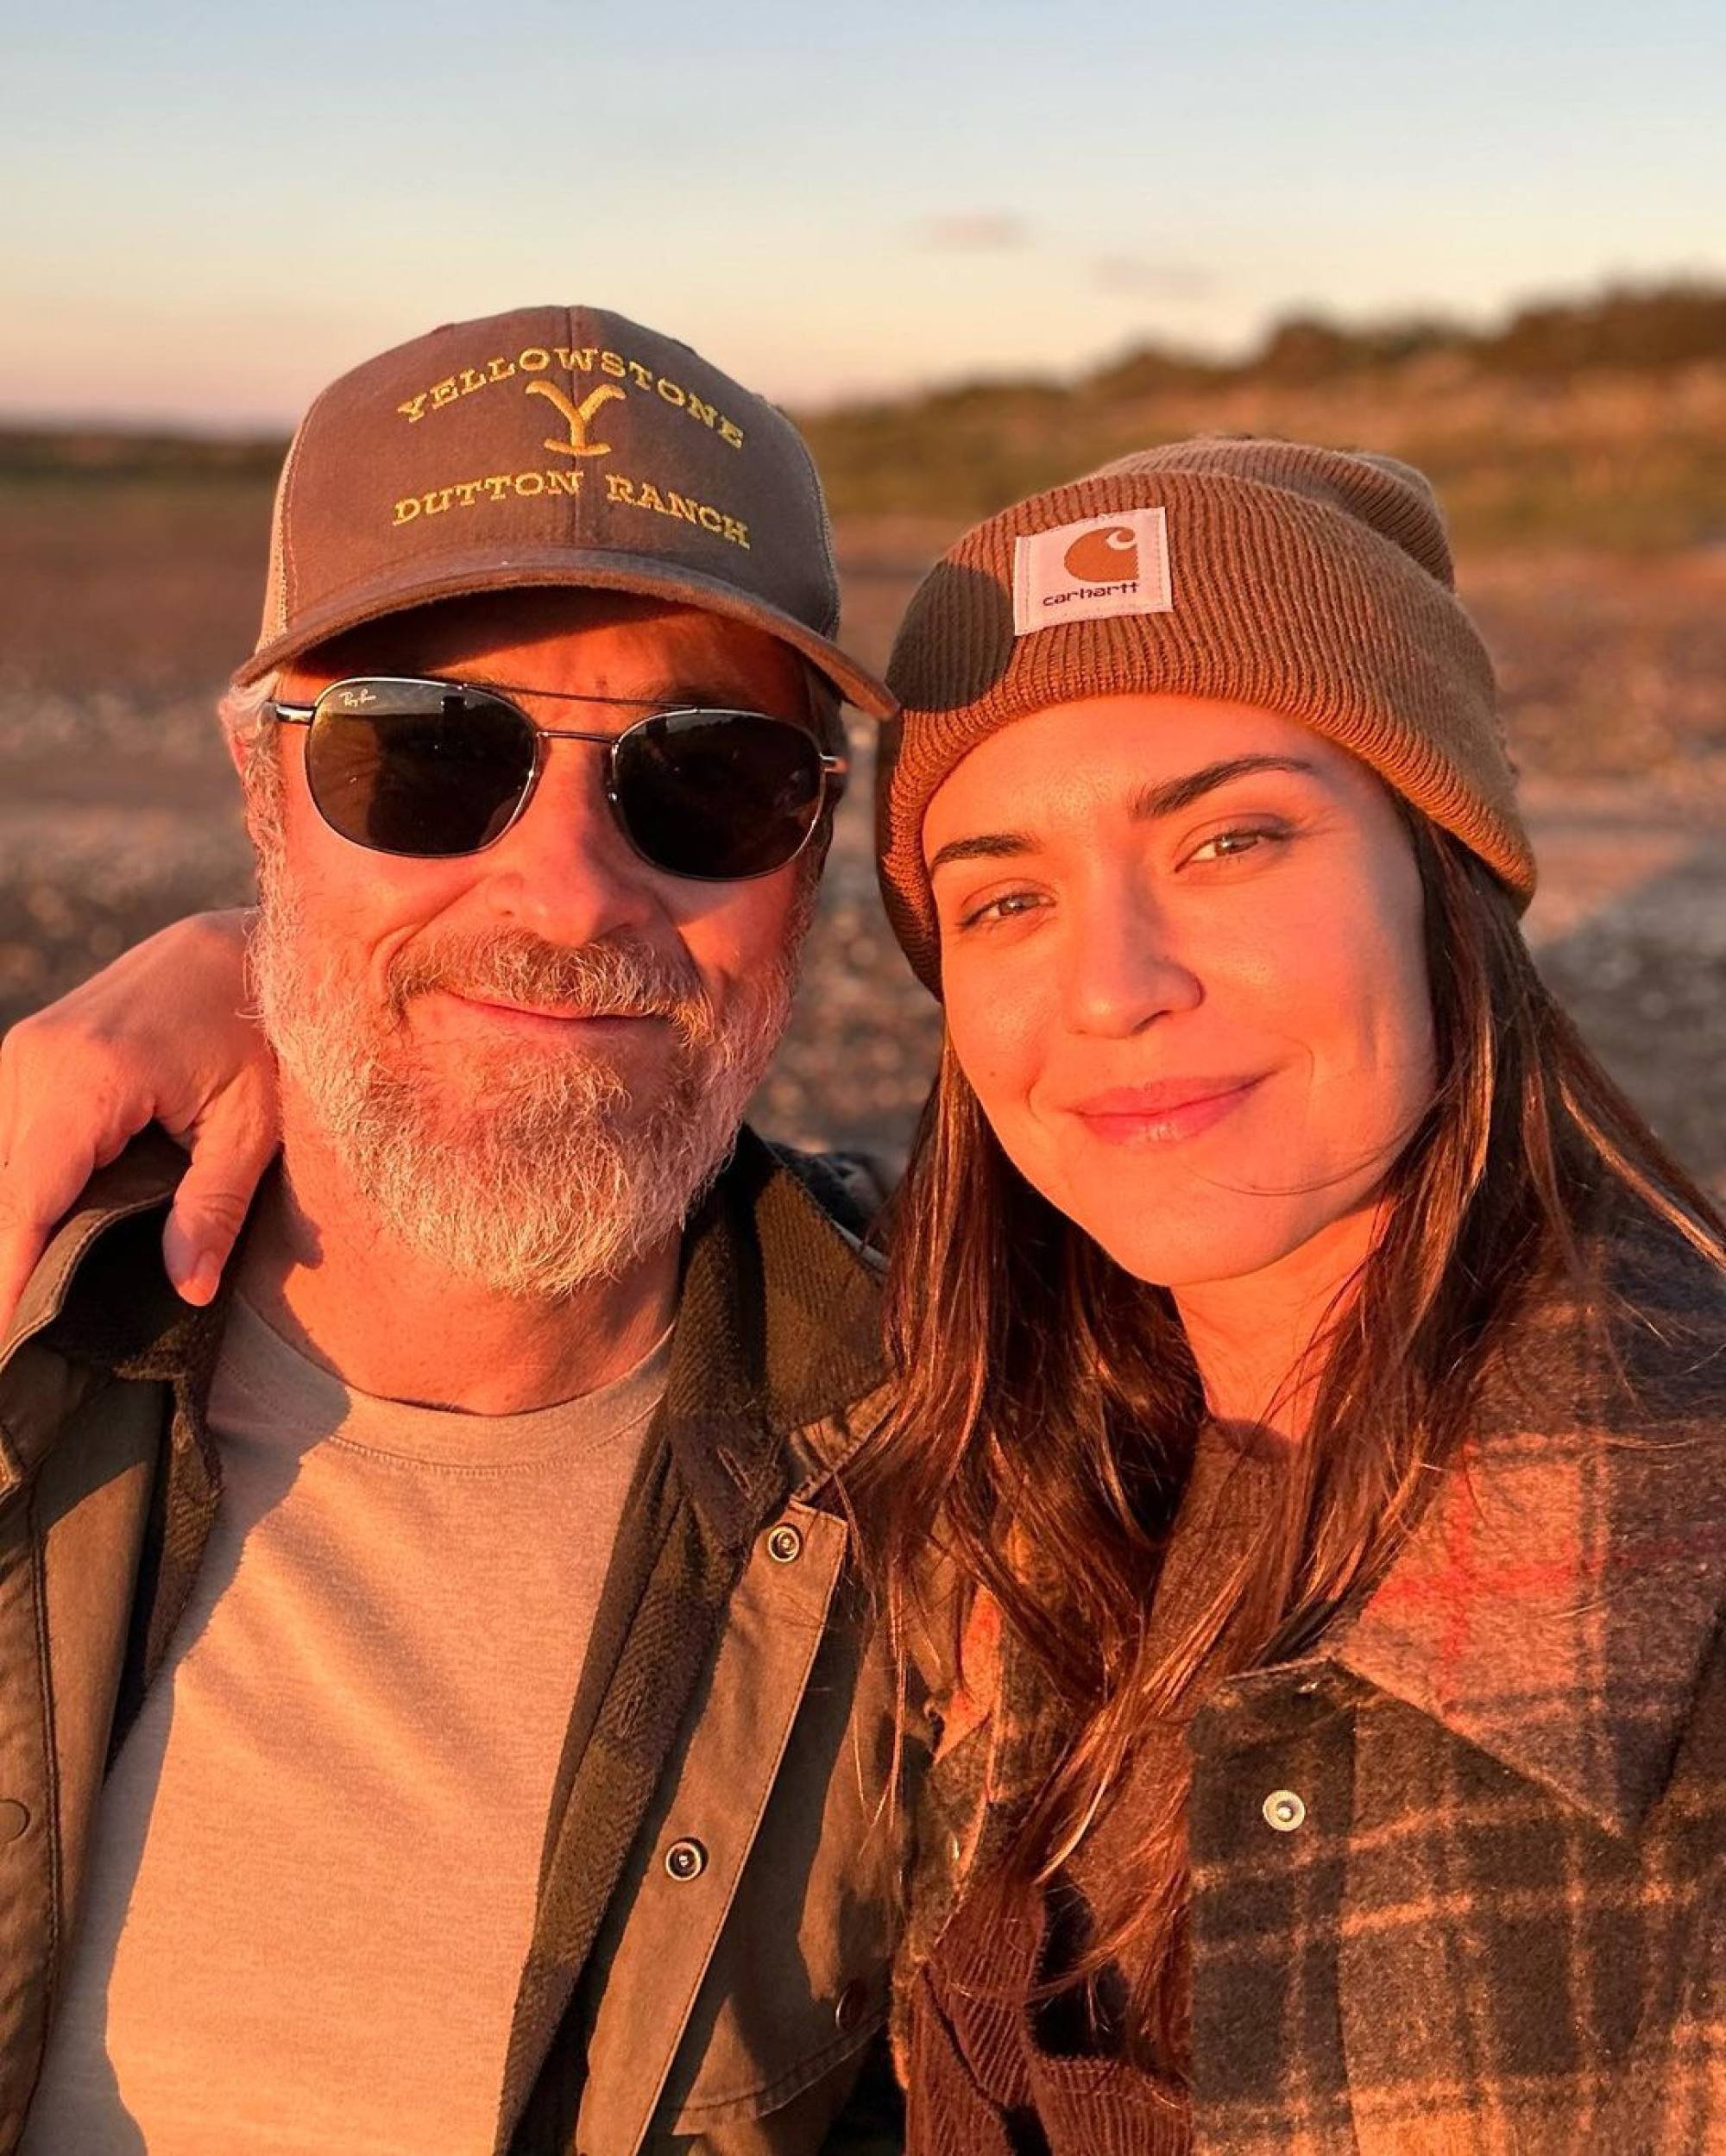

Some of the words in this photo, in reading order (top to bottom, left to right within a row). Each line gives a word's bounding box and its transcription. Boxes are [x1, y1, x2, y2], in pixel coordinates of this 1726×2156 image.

[397, 345, 744, 449] YELLOWSTONE
[393, 470, 584, 526] DUTTON
[605, 473, 751, 551] RANCH
[1043, 581, 1140, 607] carhartt
